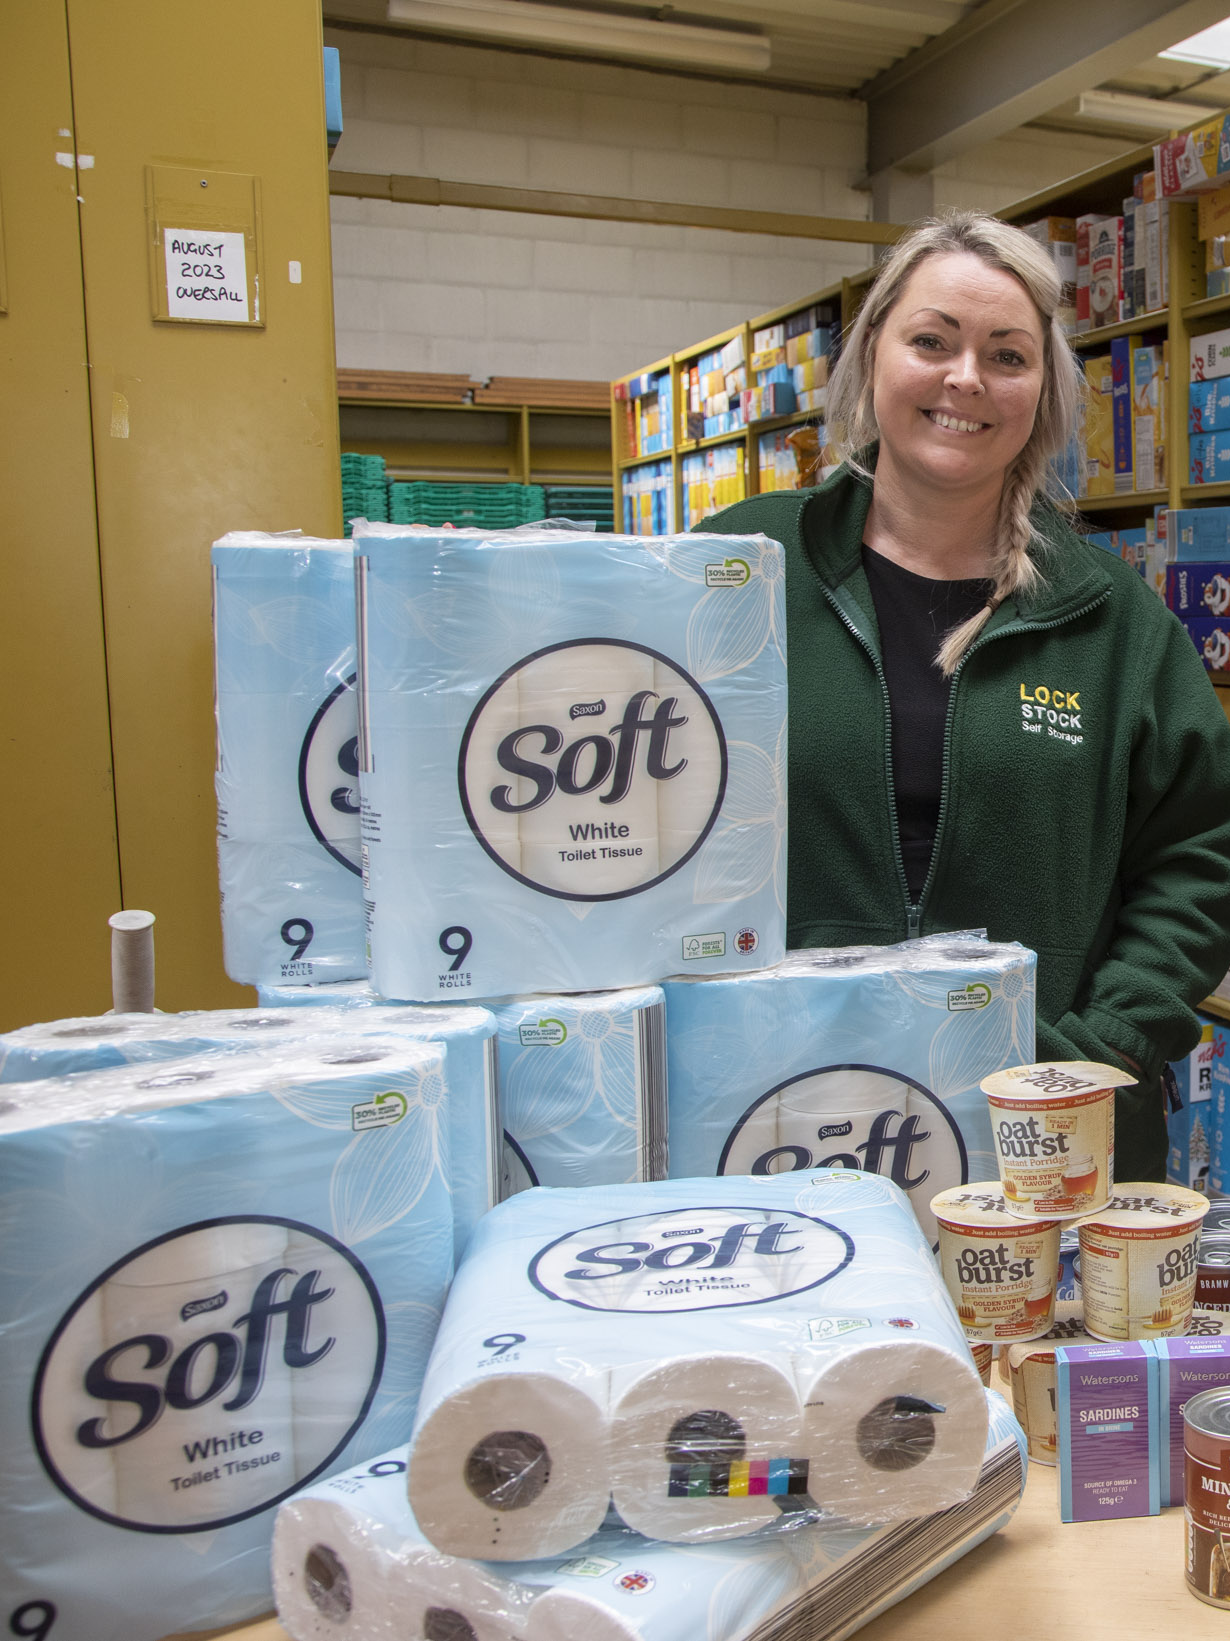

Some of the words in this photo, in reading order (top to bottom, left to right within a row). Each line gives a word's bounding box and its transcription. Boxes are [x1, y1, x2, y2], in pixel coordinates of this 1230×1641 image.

[172, 240, 224, 258] AUGUST
[181, 262, 225, 280] 2023
[1020, 683, 1081, 710] LOCK
[572, 702, 603, 716] Saxon
[1021, 703, 1082, 728] STOCK
[1022, 721, 1042, 732] Self
[1047, 726, 1083, 745] Storage
[490, 690, 689, 814] Soft
[569, 822, 630, 841] White
[558, 850, 596, 862] Toilet
[600, 846, 643, 859] Tissue
[280, 918, 314, 961] 9
[439, 926, 473, 971] 9
[280, 962, 313, 970] WHITE
[281, 969, 313, 977] ROLLS
[439, 972, 472, 981] WHITE
[439, 980, 472, 988] ROLLS
[999, 1116, 1041, 1140] oat
[997, 1132, 1070, 1158] burst
[1003, 1158, 1028, 1167] Instant
[1030, 1155, 1069, 1168] Porridge
[564, 1222, 805, 1280] Soft
[961, 1243, 1009, 1266] oat
[1165, 1234, 1198, 1268] oat
[658, 1275, 734, 1287] White
[955, 1257, 1034, 1284] burst
[643, 1285, 690, 1297] Toilet
[695, 1282, 751, 1293] Tissue
[962, 1285, 992, 1293] Instant
[995, 1280, 1033, 1292] Porridge
[483, 1333, 526, 1356] 9
[76, 1267, 336, 1449] Soft
[1080, 1374, 1139, 1386] Watersons
[1080, 1406, 1140, 1422] SARDINES
[183, 1429, 264, 1464] White
[170, 1466, 221, 1492] Toilet
[224, 1450, 281, 1477] Tissue
